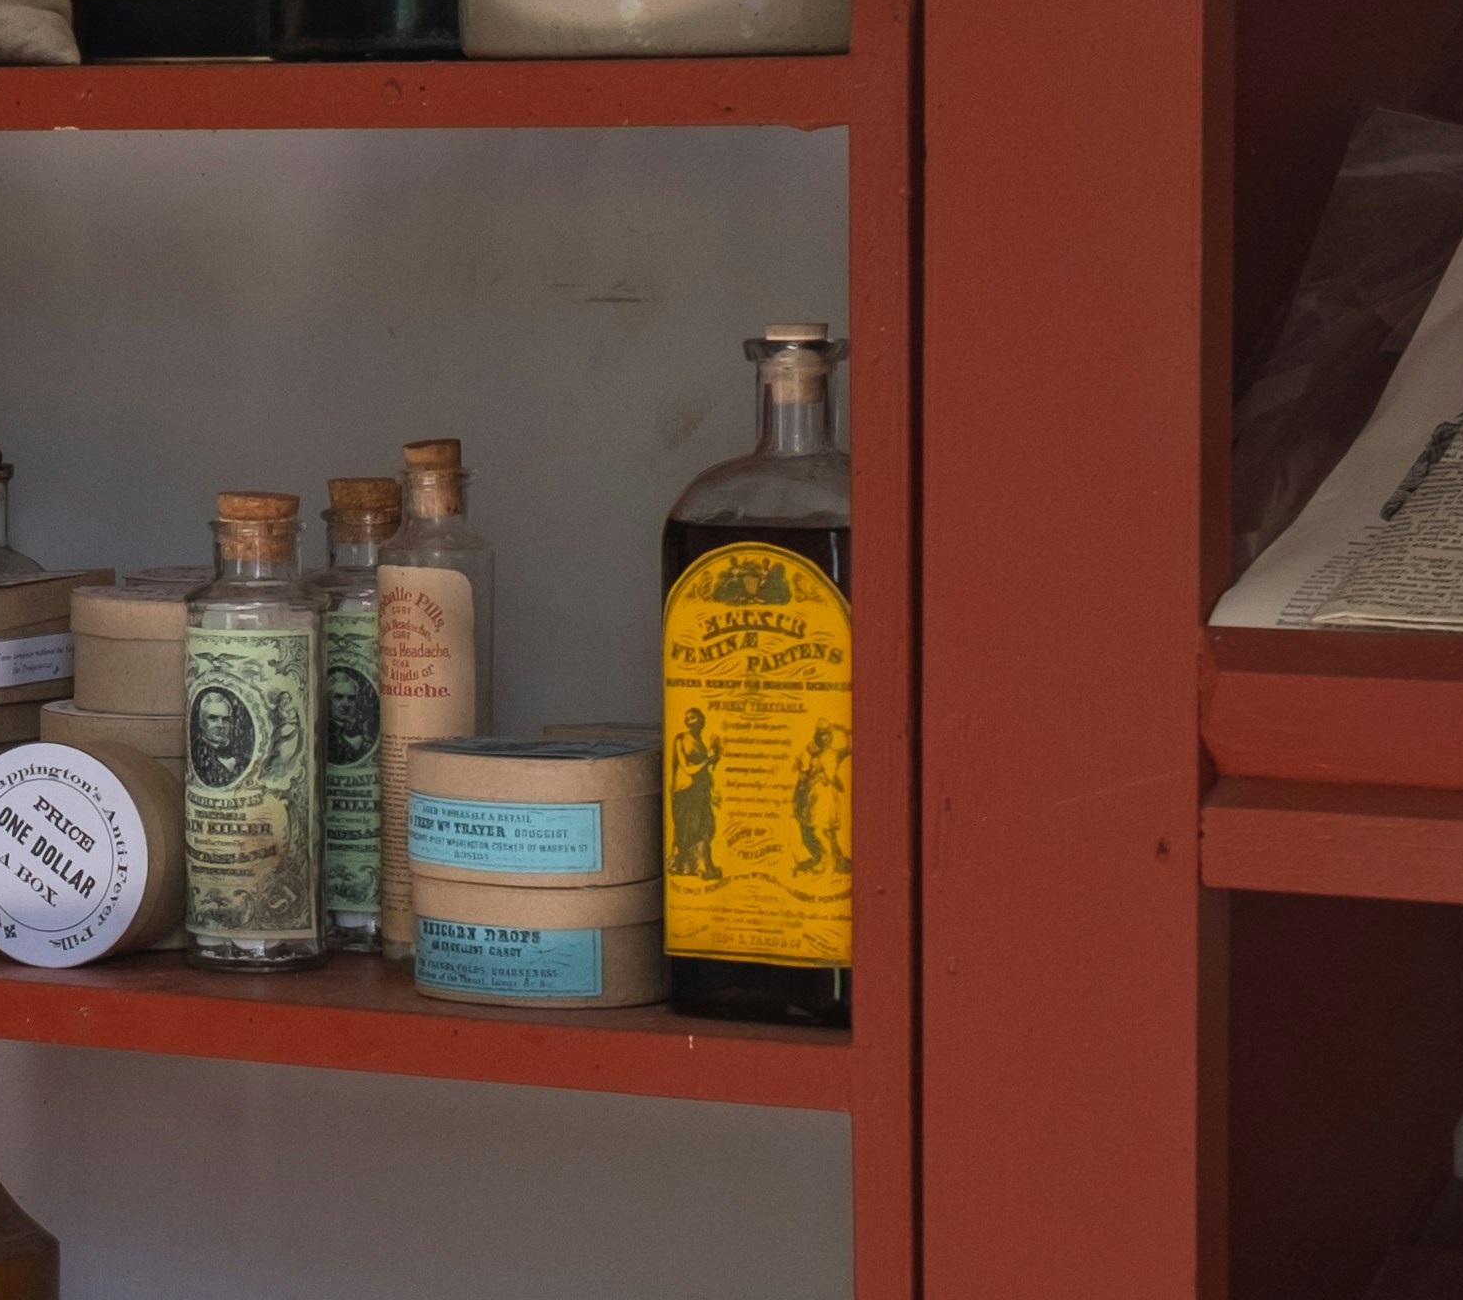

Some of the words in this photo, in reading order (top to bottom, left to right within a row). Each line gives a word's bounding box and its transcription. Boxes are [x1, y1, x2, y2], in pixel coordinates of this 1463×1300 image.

[399, 643, 451, 659] Headache,
[421, 664, 434, 678] of
[380, 681, 451, 698] eadache.
[33, 796, 96, 853] PRICE
[498, 814, 532, 823] RETAIL
[207, 822, 273, 835] KILLER
[455, 823, 505, 838] THAYER
[30, 835, 96, 898] DOLLAR
[97, 807, 128, 926] Anti-Fever
[14, 863, 59, 907] BOX
[484, 929, 541, 944] DROPS
